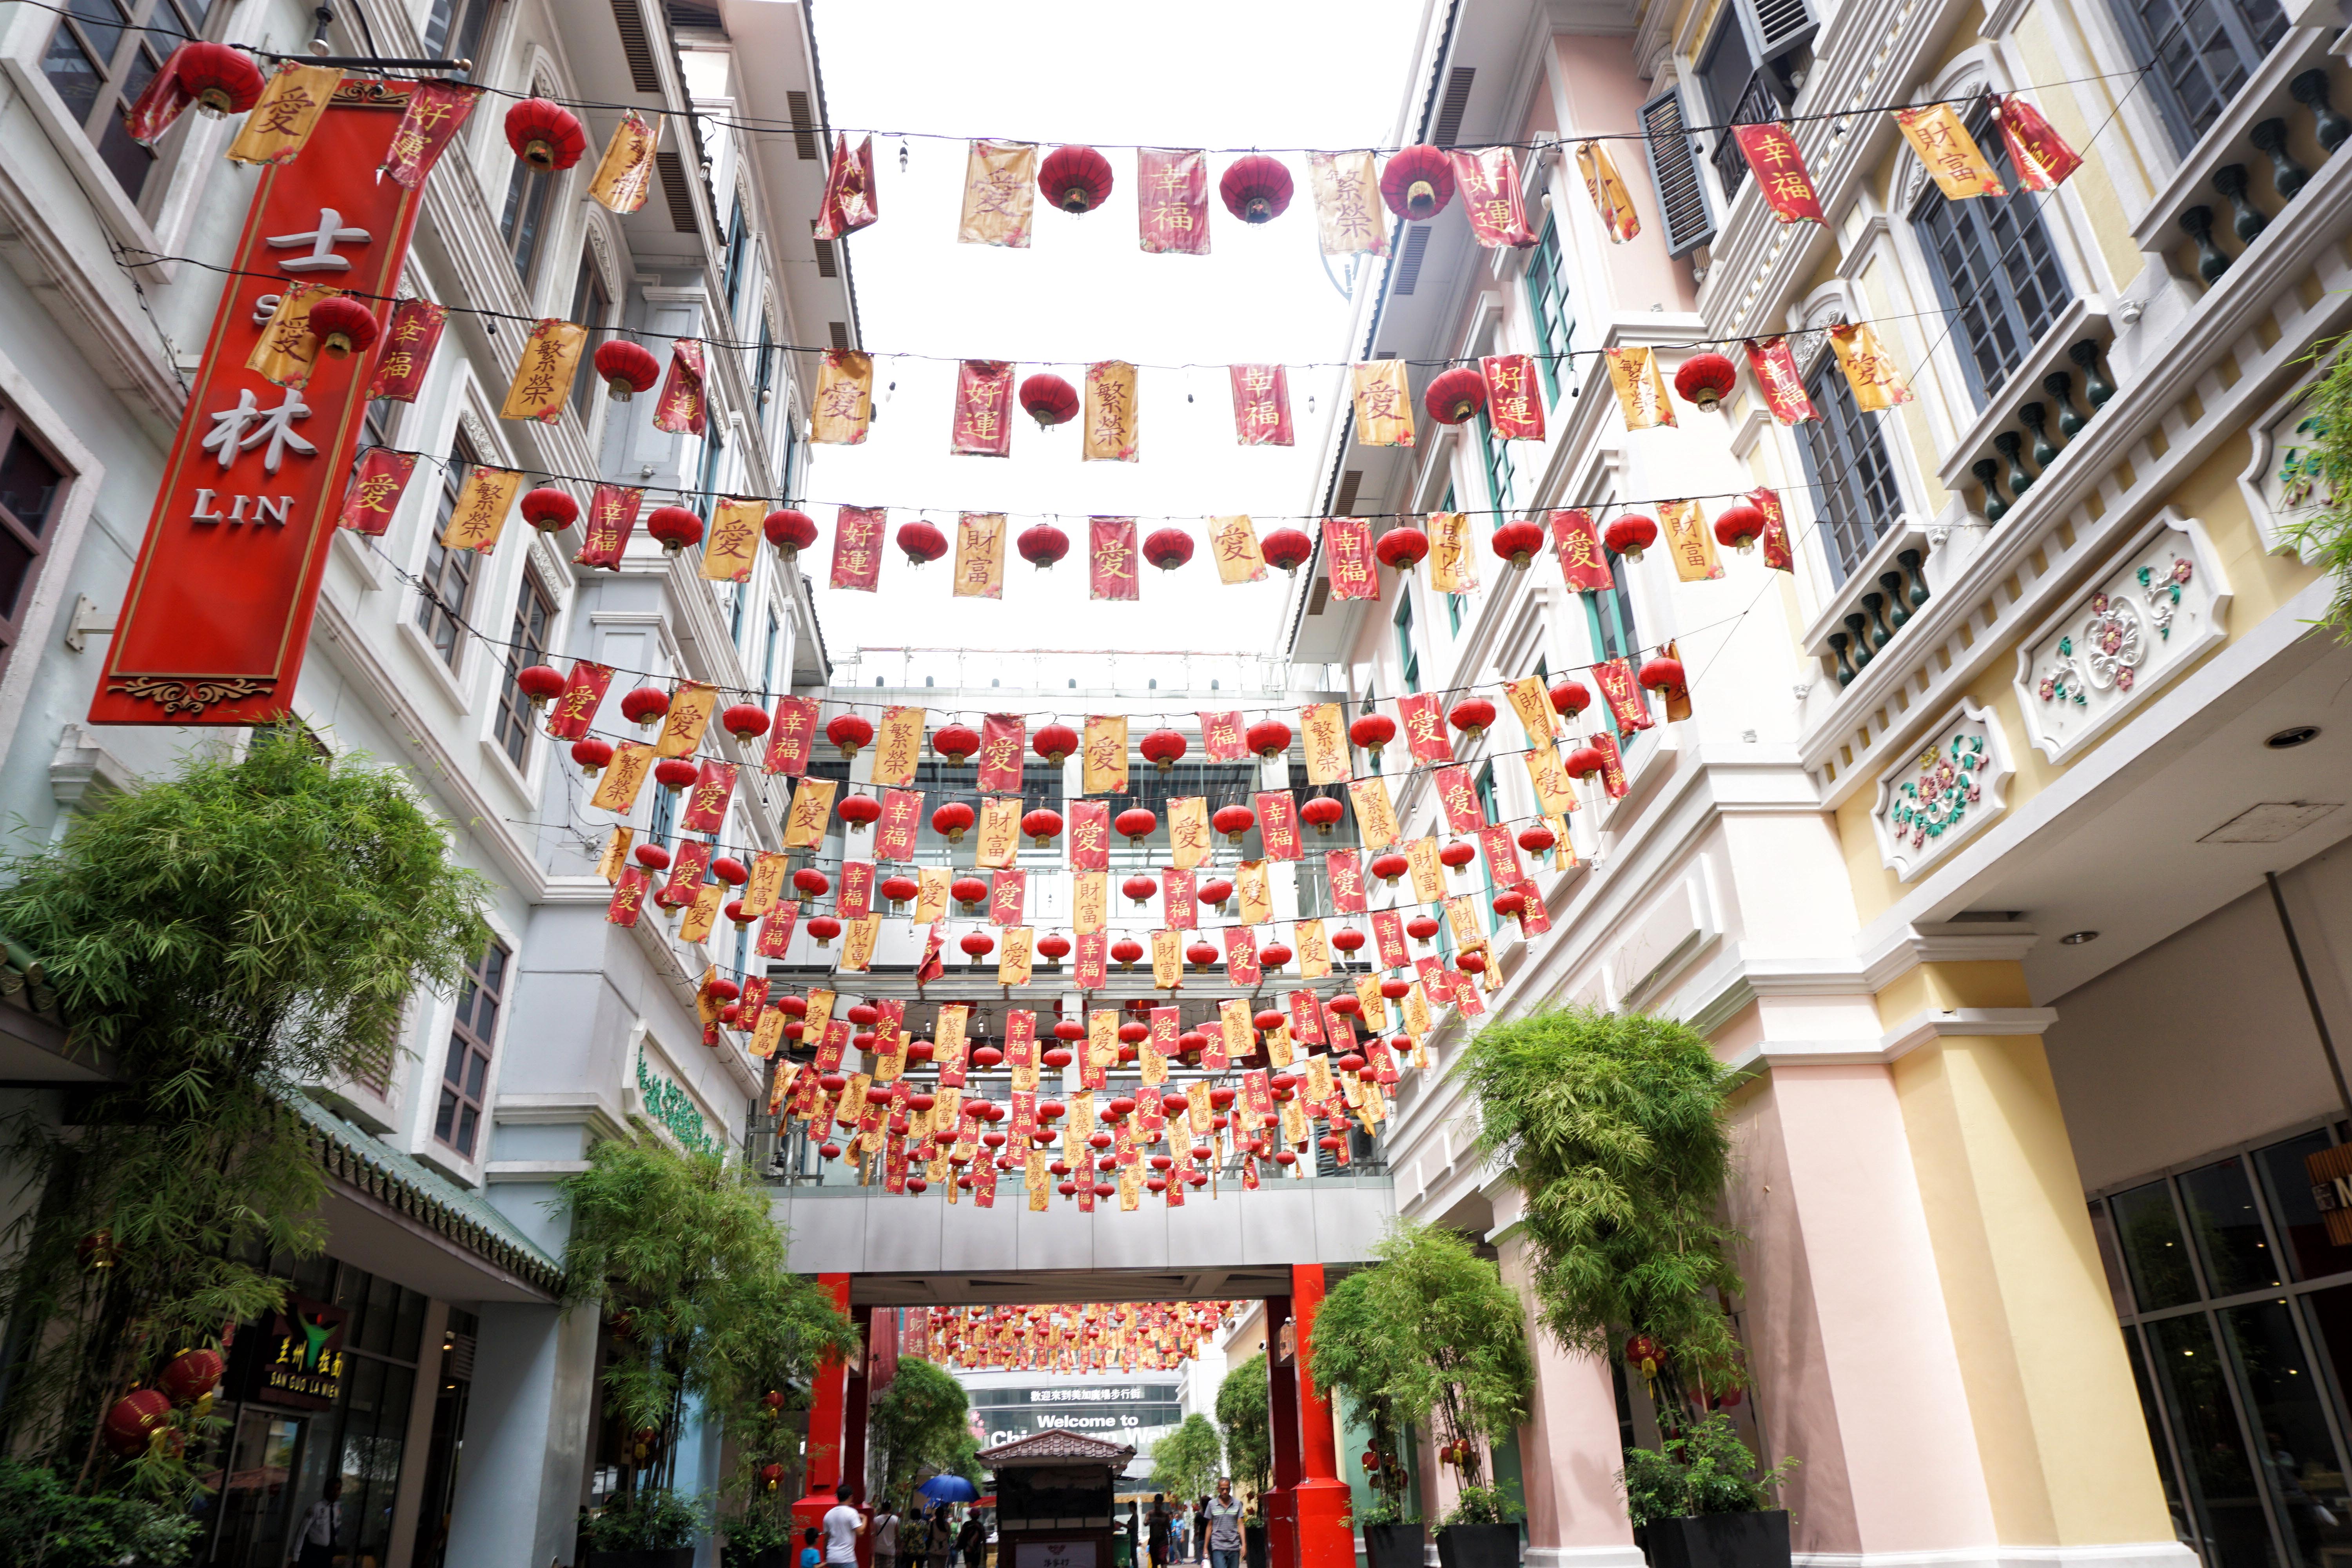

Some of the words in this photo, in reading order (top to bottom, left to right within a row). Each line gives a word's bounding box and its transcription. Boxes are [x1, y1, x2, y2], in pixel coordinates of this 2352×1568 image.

[253, 86, 316, 136] 愛
[391, 97, 453, 168] 好運
[1754, 134, 1812, 201] 幸福
[1915, 121, 1977, 182] 財富
[971, 167, 1025, 216] 愛
[1150, 164, 1193, 232] 幸福
[1325, 169, 1373, 238] 繁榮
[1463, 167, 1521, 234] 好運
[266, 207, 372, 271] 士
[381, 316, 426, 379] 幸福
[522, 340, 566, 406] 繁榮
[822, 381, 866, 421] 愛
[962, 380, 1003, 440] 好運
[1093, 381, 1127, 447] 繁榮
[1241, 369, 1279, 426] 幸福
[1360, 380, 1406, 421] 愛
[1490, 366, 1537, 425] 好運
[202, 388, 319, 475] 林
[191, 488, 294, 525] LIN
[355, 473, 399, 513] 愛
[459, 483, 512, 540] 繁榮
[588, 499, 627, 552] 幸福
[713, 519, 754, 559] 愛
[1215, 524, 1256, 561] 愛
[1670, 516, 1705, 567] 財富
[836, 522, 875, 576] 好運
[965, 530, 996, 584] 財富
[1094, 539, 1134, 578] 愛
[1334, 530, 1367, 583] 幸福
[1563, 529, 1602, 568] 愛
[561, 685, 596, 720] 愛
[1605, 675, 1643, 721] 好運
[667, 705, 703, 740] 愛
[773, 710, 807, 760] 幸福
[1408, 708, 1446, 744] 愛
[884, 723, 913, 775] 繁榮
[985, 737, 1019, 772] 愛
[1089, 736, 1123, 771] 愛
[1310, 721, 1339, 772] 繁榮
[606, 755, 641, 802] 繁榮
[694, 780, 726, 814] 愛
[1537, 767, 1570, 798] 愛
[794, 797, 826, 831] 愛
[1360, 791, 1390, 838] 繁榮
[1445, 784, 1479, 817] 愛
[882, 802, 912, 847] 幸福
[985, 811, 1011, 858] 財富
[1074, 818, 1105, 852] 愛
[1174, 817, 1205, 849] 愛
[1264, 802, 1293, 848] 幸福
[673, 859, 701, 889] 愛
[1413, 851, 1437, 892] 財富
[1488, 836, 1516, 876] 幸福
[615, 884, 642, 911] 愛
[753, 866, 779, 906] 財富
[843, 867, 867, 907] 幸福
[920, 878, 945, 907] 愛
[995, 880, 1022, 910] 愛
[1169, 877, 1188, 918] 幸福
[1242, 879, 1269, 907] 愛
[1334, 868, 1363, 897] 愛
[688, 900, 714, 927] 愛
[1079, 882, 1100, 924] 財富
[764, 908, 789, 946] 幸福
[851, 923, 873, 961] 財富
[1379, 920, 1403, 956] 幸福
[1004, 942, 1027, 969] 愛
[1080, 939, 1100, 978] 幸福
[1158, 942, 1176, 980] 財富
[1230, 943, 1255, 970] 愛
[1301, 936, 1327, 963] 愛
[1423, 967, 1448, 992] 愛
[1456, 983, 1477, 1006] 愛
[739, 987, 762, 1022] 好運
[804, 1006, 825, 1031] 愛
[1296, 1000, 1317, 1035] 幸福
[1364, 991, 1384, 1017] 愛
[761, 1017, 779, 1050] 財富
[820, 1029, 842, 1062] 幸福
[877, 1016, 898, 1042] 愛
[941, 1017, 959, 1053] 繁榮
[1009, 1020, 1029, 1056] 幸福
[1093, 1027, 1114, 1051] 愛
[1154, 1016, 1176, 1042] 愛
[1228, 1012, 1247, 1048] 繁榮
[1372, 1052, 1393, 1075] 愛
[799, 1073, 817, 1102] 幸福
[1248, 1076, 1267, 1105] 幸福
[938, 1093, 953, 1124] 財富
[1016, 1096, 1031, 1126] 幸福
[1074, 1102, 1089, 1133] 繁榮
[1139, 1096, 1160, 1118] 愛
[1192, 1092, 1208, 1123] 財富
[1117, 1135, 1135, 1154] 愛
[974, 1158, 991, 1177] 愛
[1037, 1415, 1115, 1428] Welcome
[1120, 1415, 1138, 1426] to
